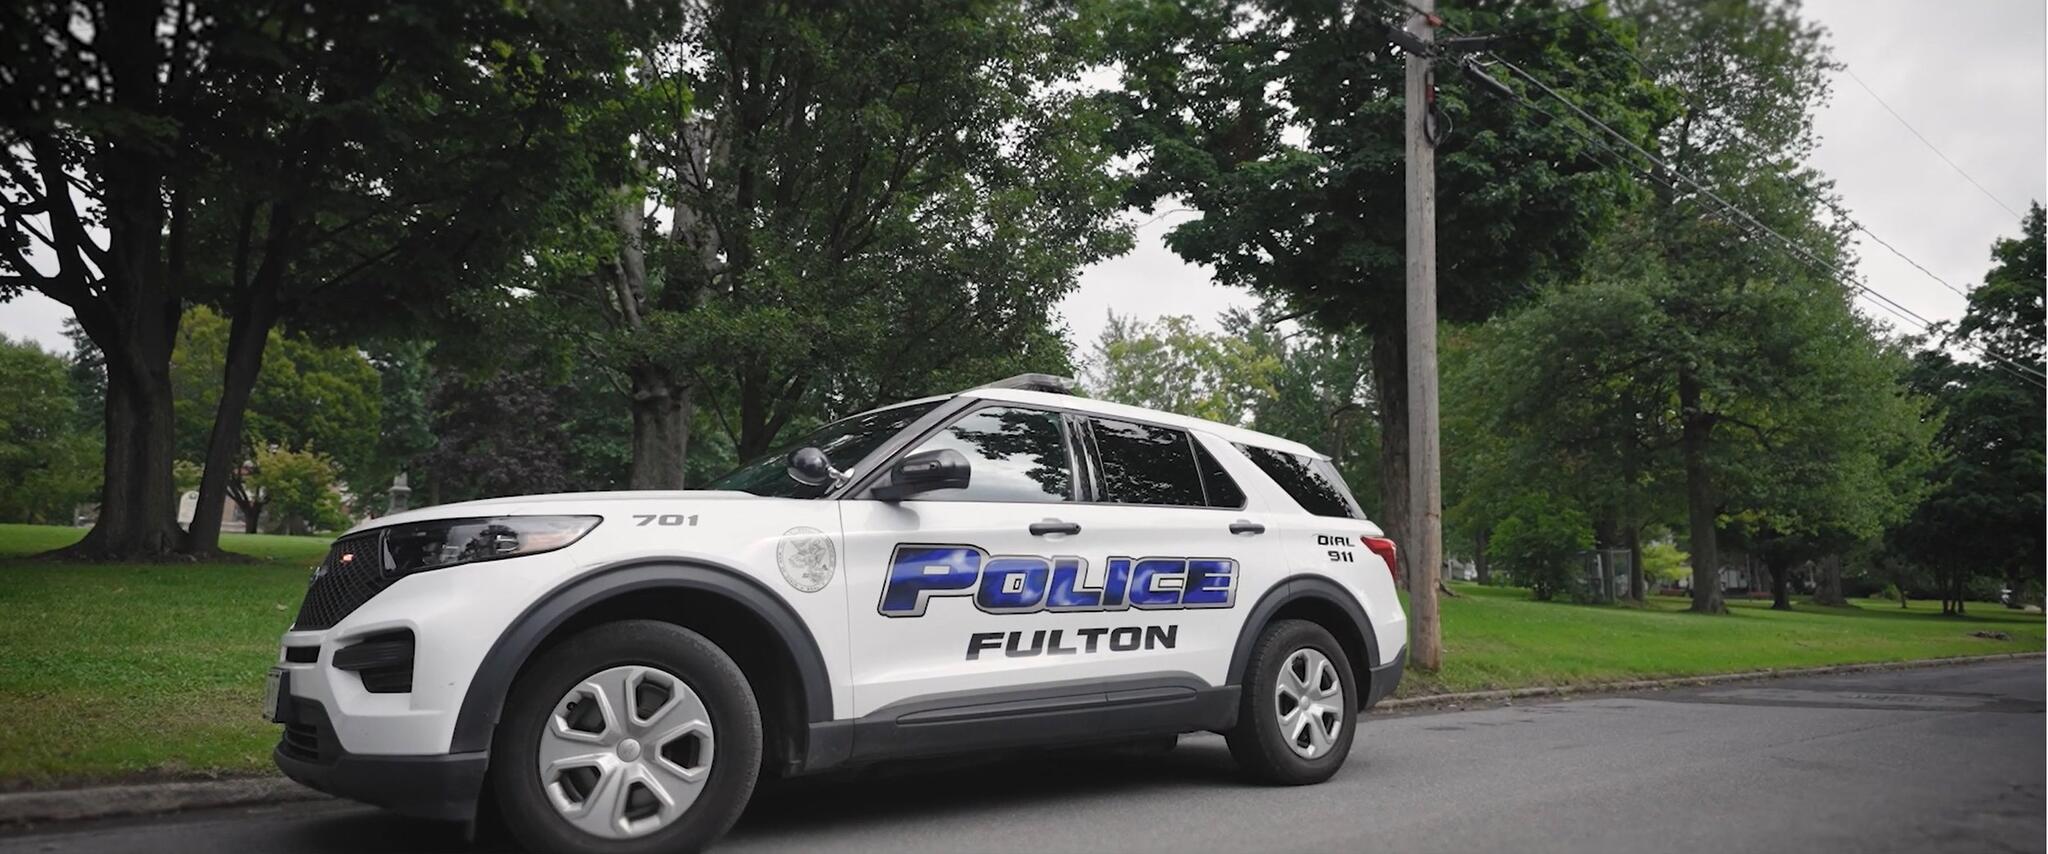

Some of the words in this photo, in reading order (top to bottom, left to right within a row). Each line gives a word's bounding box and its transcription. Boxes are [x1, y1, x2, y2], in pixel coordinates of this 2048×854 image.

[632, 514, 699, 527] 701
[1317, 535, 1355, 547] DIAL
[1327, 550, 1354, 563] 911
[878, 543, 1239, 617] POLICE
[965, 625, 1177, 660] FULTON
